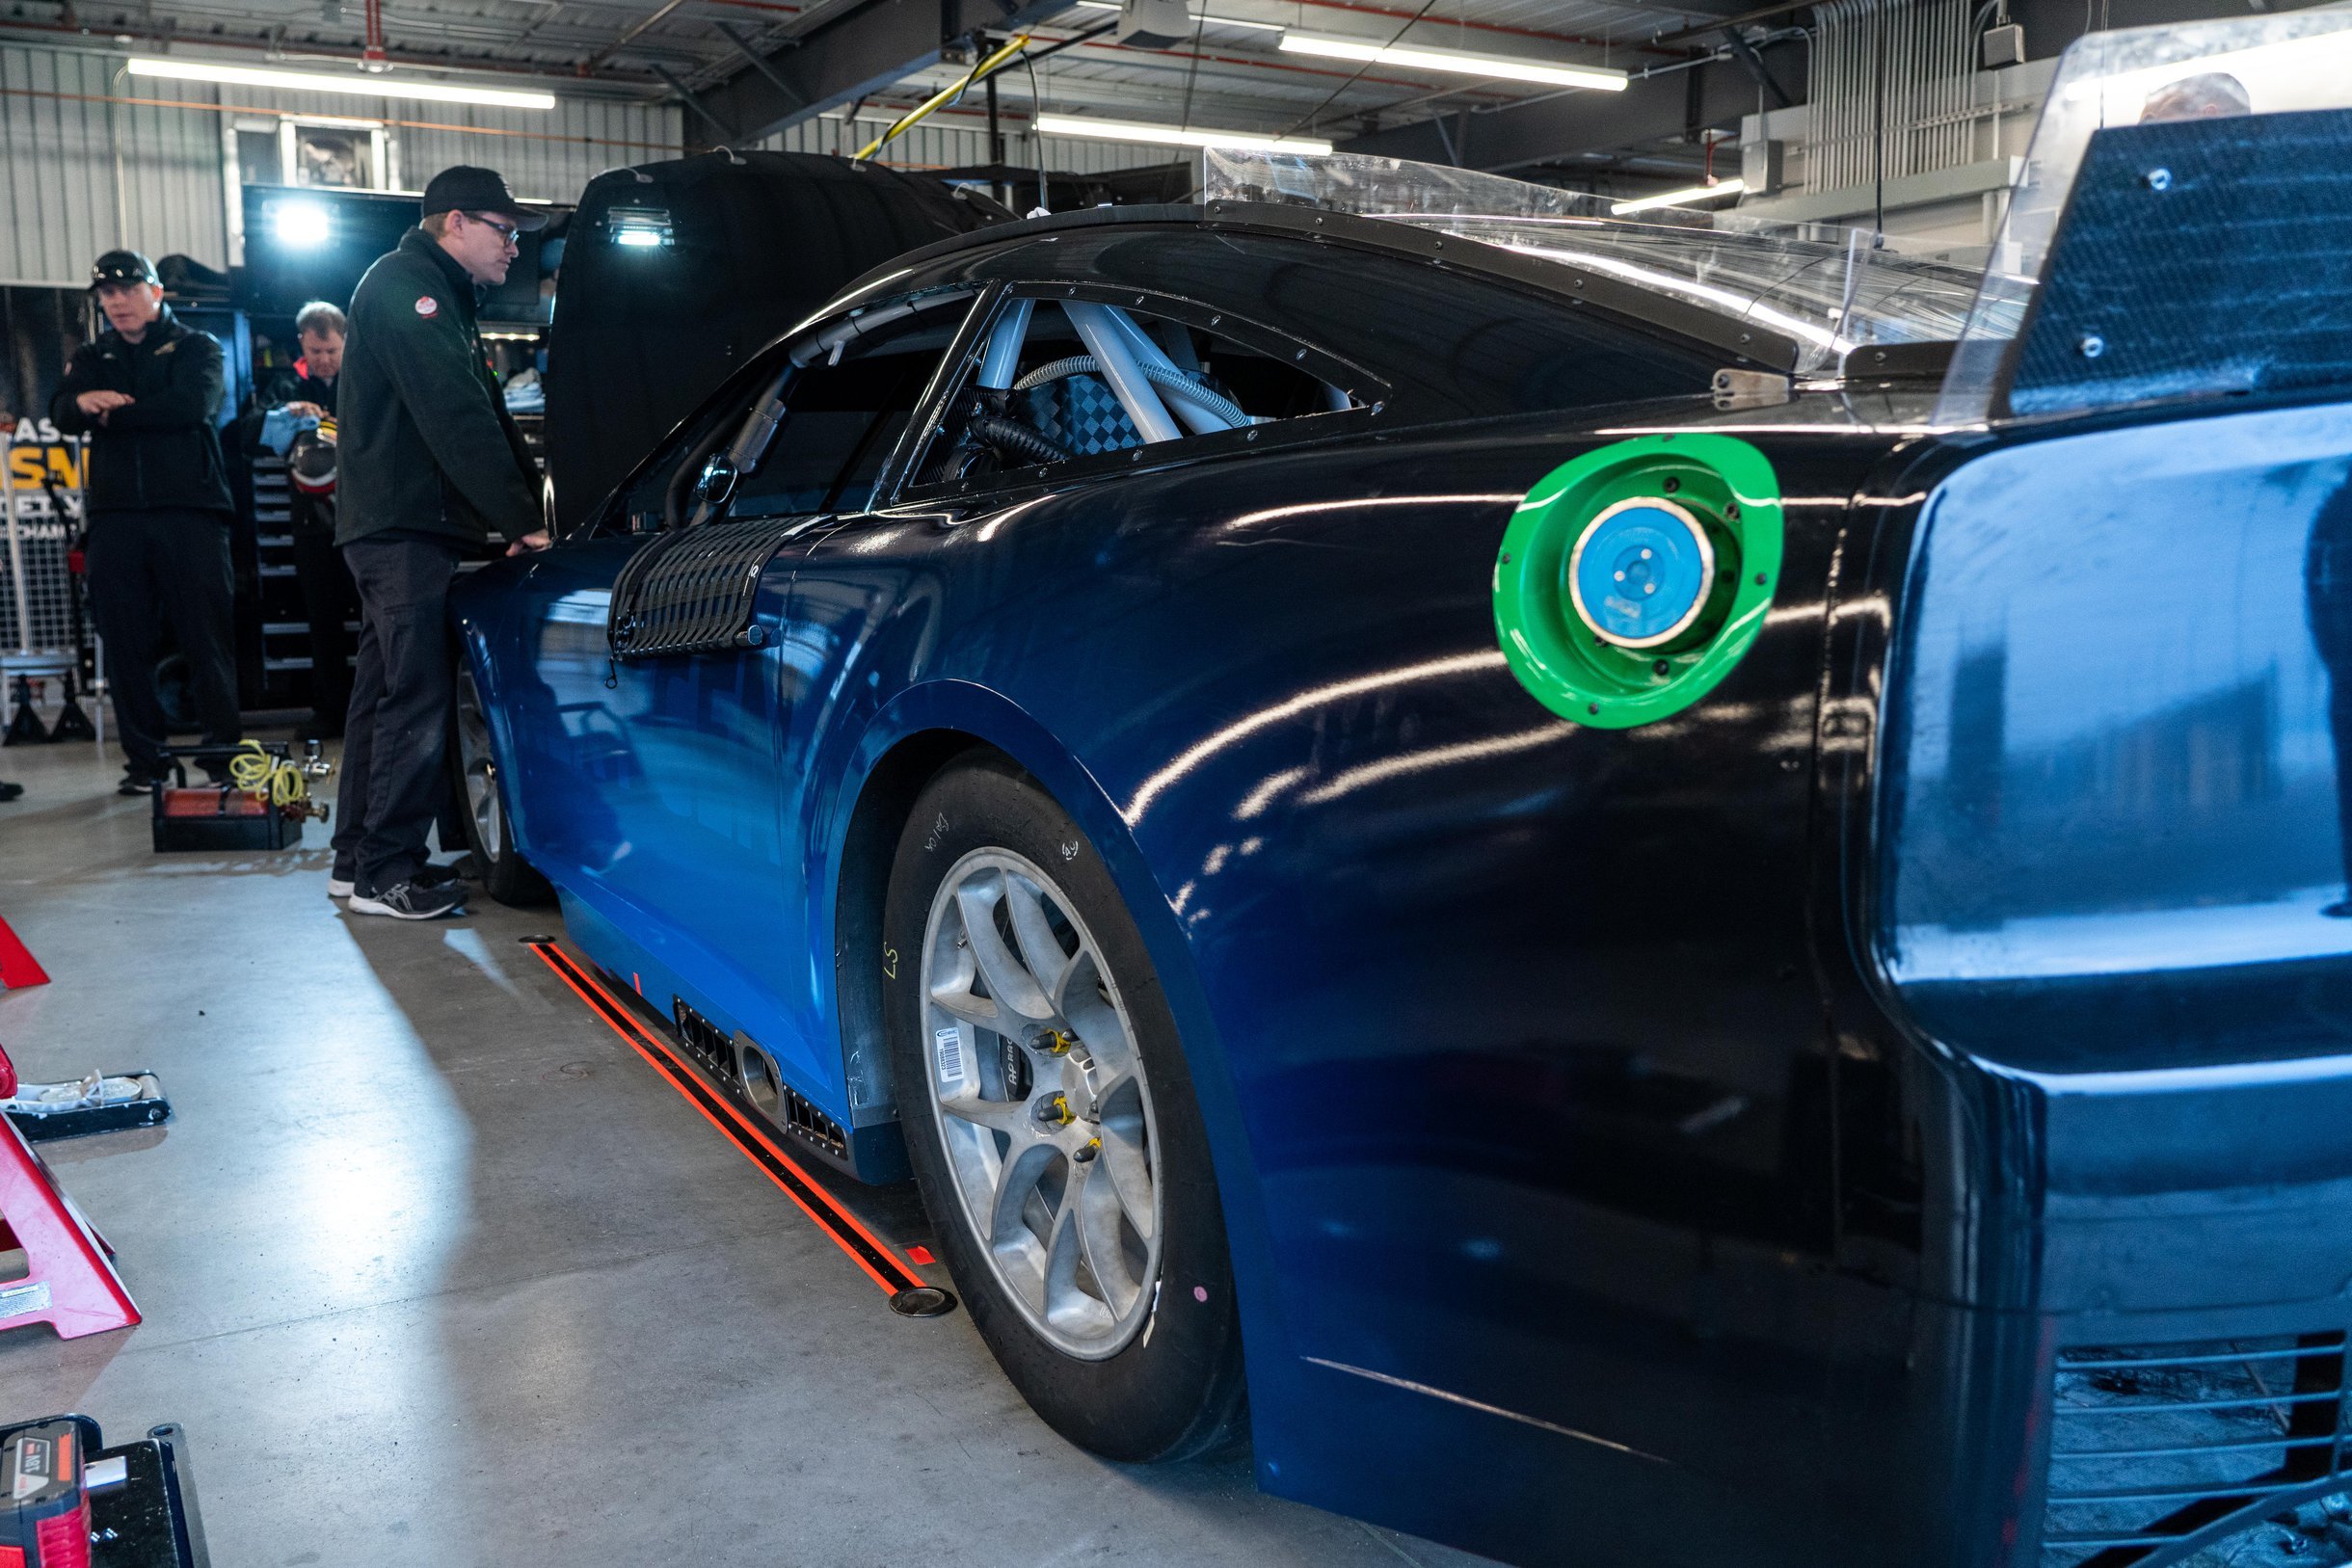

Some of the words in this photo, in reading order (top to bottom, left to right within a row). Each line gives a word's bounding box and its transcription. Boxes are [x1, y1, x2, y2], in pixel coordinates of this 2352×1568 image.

[883, 941, 898, 980] LS
[1007, 1063, 1017, 1085] AP
[24, 1454, 40, 1474] 18V
